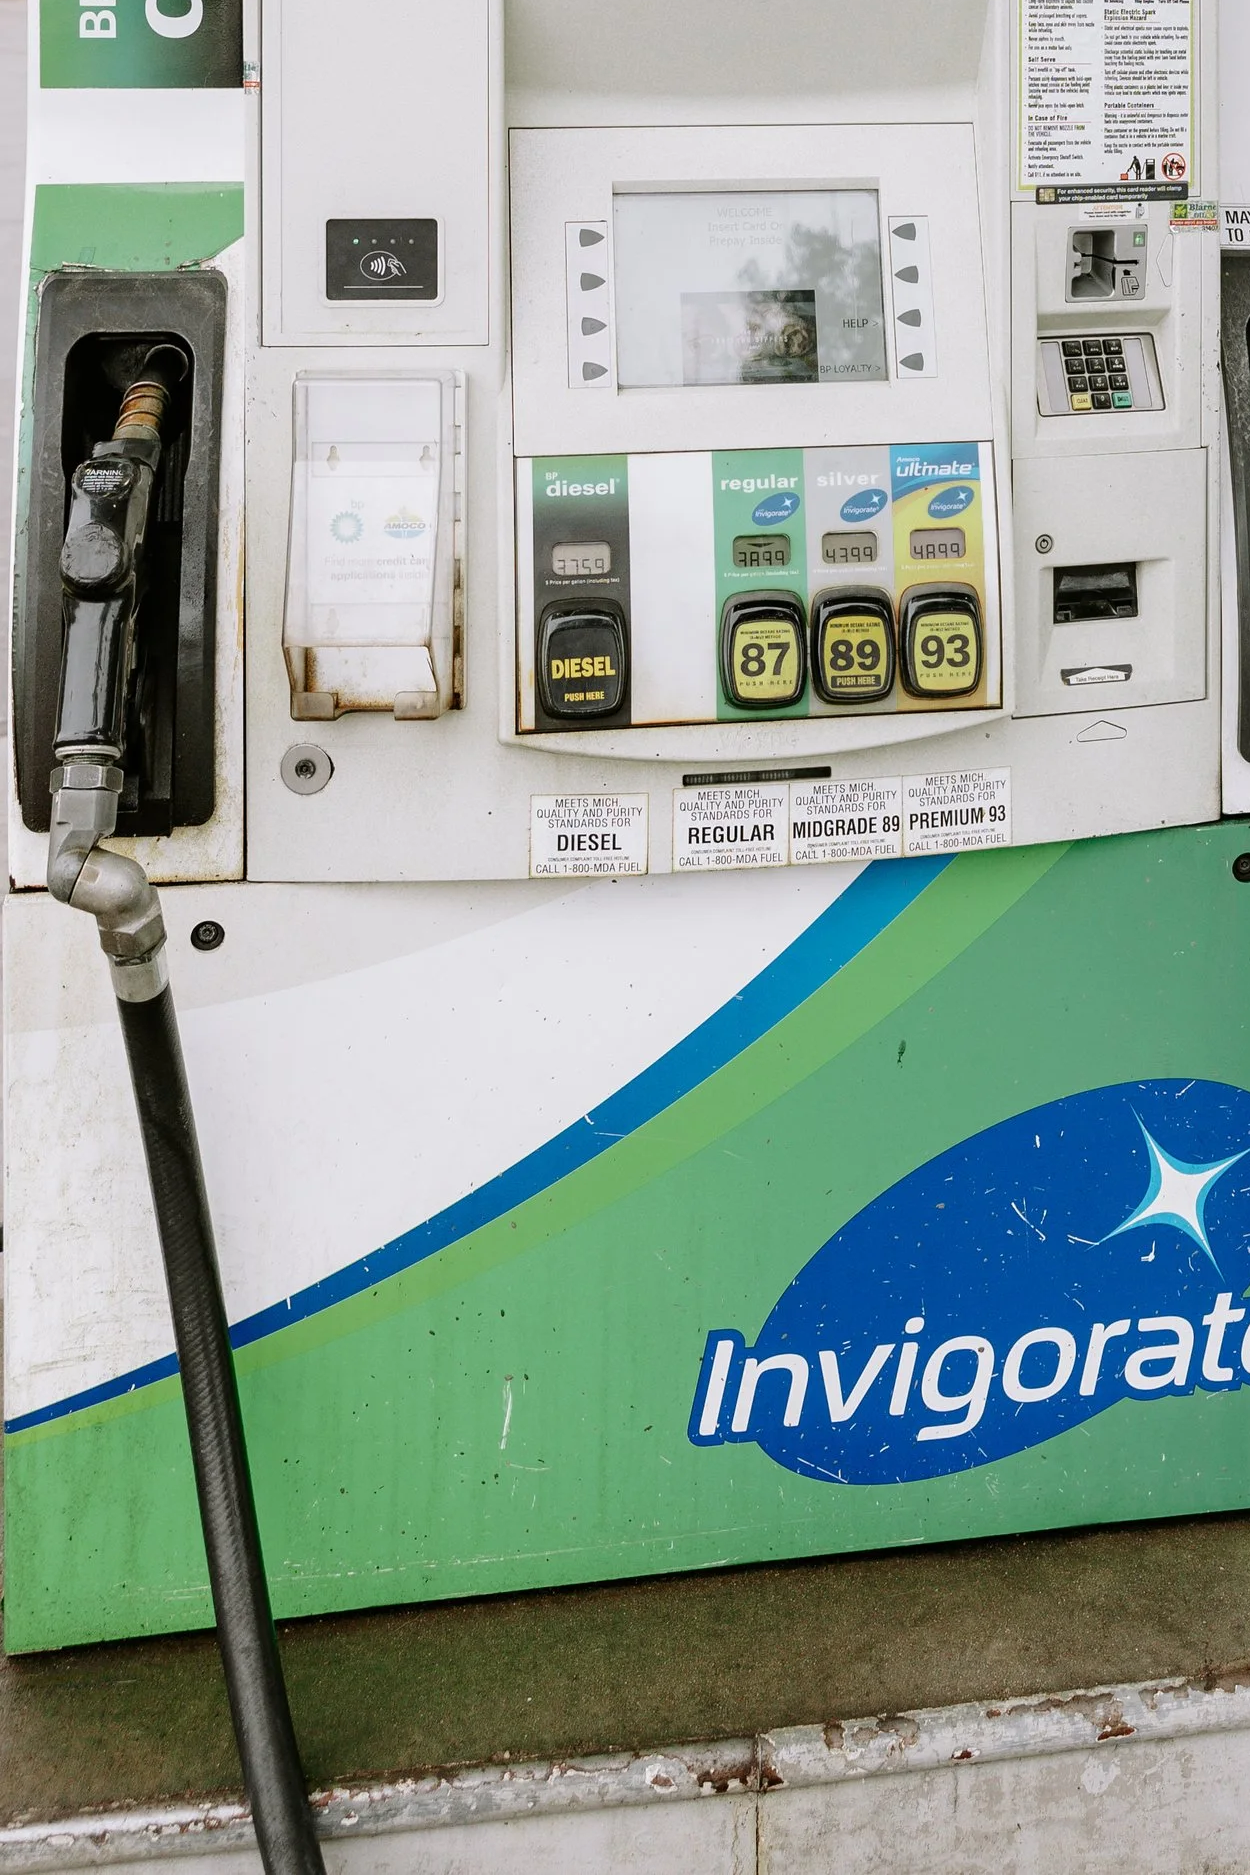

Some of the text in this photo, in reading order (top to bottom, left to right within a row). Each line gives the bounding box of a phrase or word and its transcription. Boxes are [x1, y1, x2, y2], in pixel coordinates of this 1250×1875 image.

[718, 208, 773, 217] WELCOME
[708, 222, 766, 232] Insert Card
[1226, 228, 1243, 241] TO
[710, 236, 781, 247] Prepay Inside
[843, 319, 868, 328] HELP
[820, 365, 872, 374] BP LOYALTY
[546, 472, 558, 480] BP
[817, 472, 879, 487] silver
[721, 474, 798, 493] regular
[830, 640, 880, 671] 89
[921, 634, 970, 668] 93
[741, 642, 790, 677] 87
[552, 656, 616, 679] DIESEL
[837, 677, 856, 685] PUSH
[564, 691, 605, 702] PUSH HERE
[698, 789, 762, 801] MEETS MICH.
[555, 798, 621, 808] MEETS MICH.
[680, 799, 783, 811] QUALITY AND PURITY
[537, 807, 642, 818] QUALITY AND PURITY
[691, 809, 772, 821] STANDARDS FOR
[910, 805, 1006, 830] PREMIUM 93
[548, 818, 631, 828] STANDARDS FOR
[793, 815, 900, 839] MIDGRADE 89
[688, 824, 774, 844] REGULAR
[558, 834, 621, 851] DIESEL
[909, 834, 1006, 852] CALL 1-800-MDA FUEL
[536, 862, 641, 873] CALL 1-800-MDA FUEL
